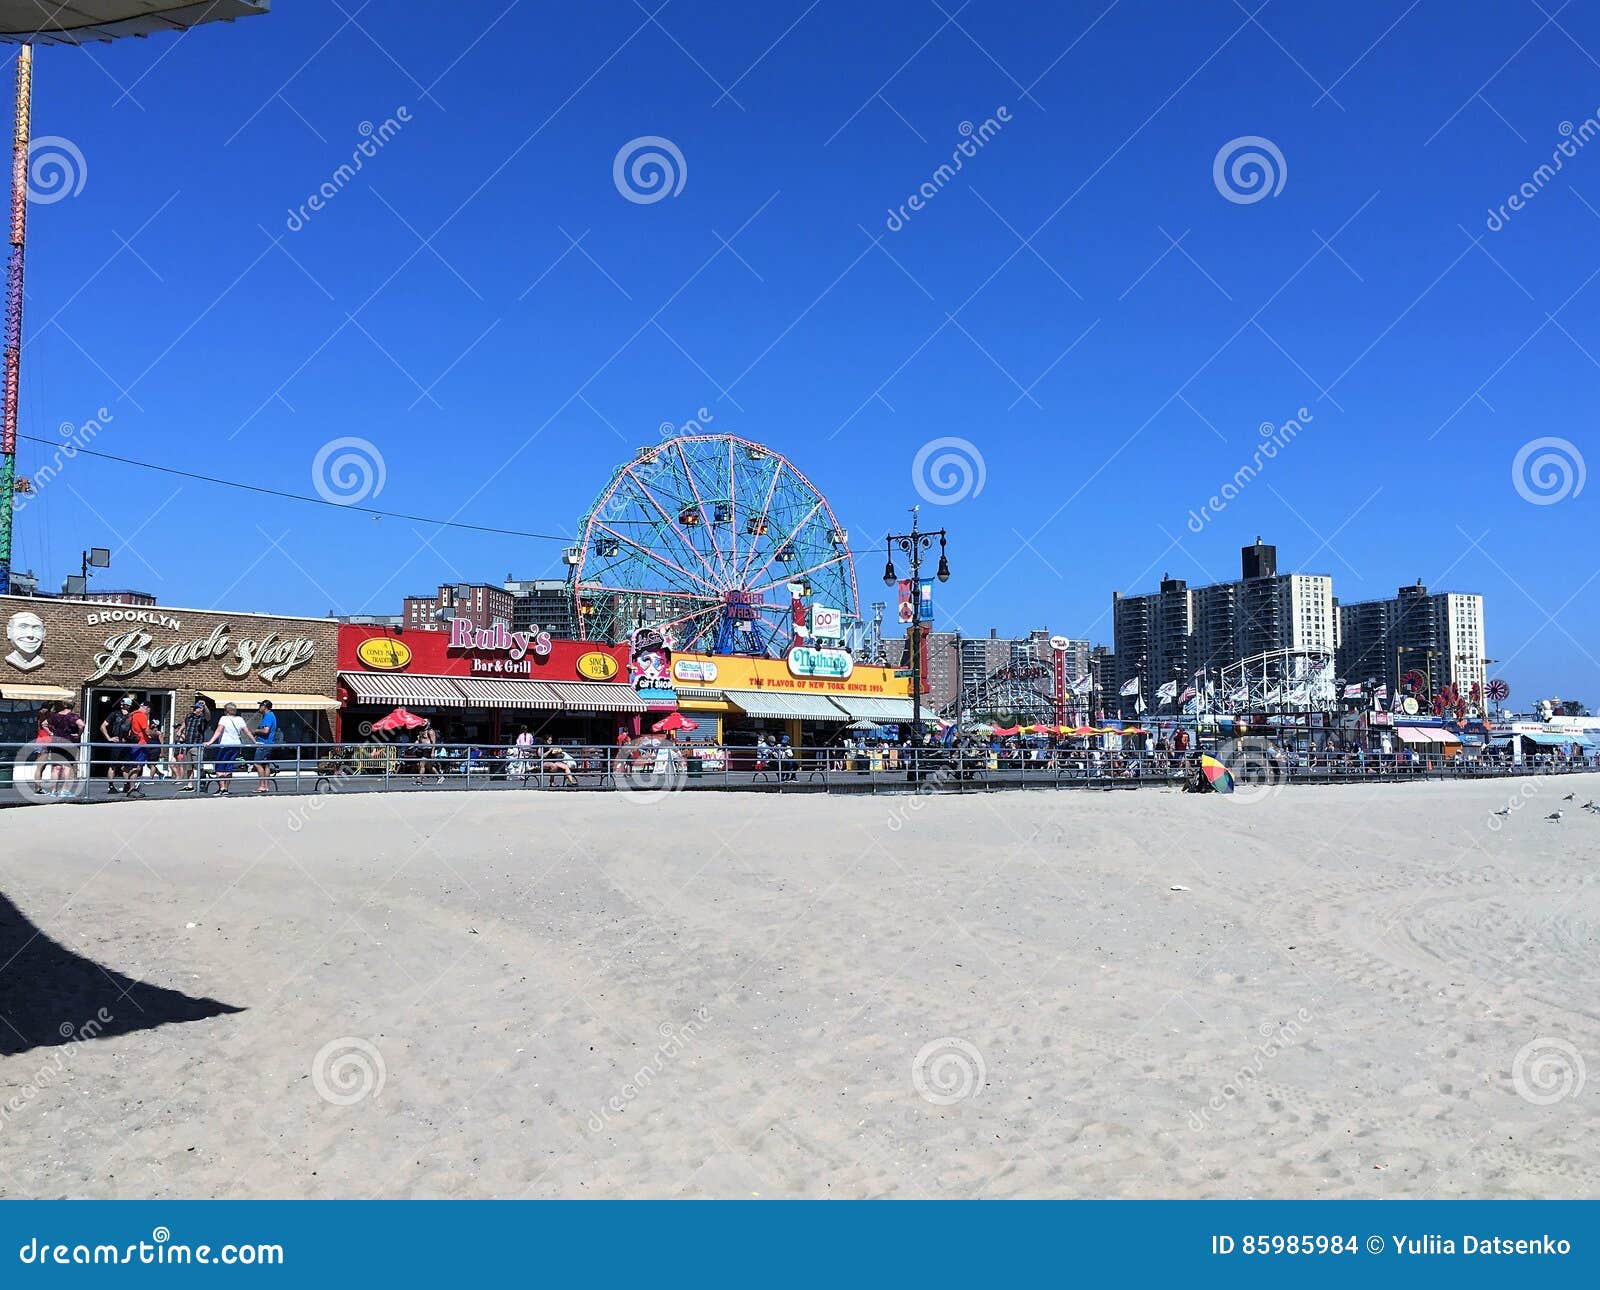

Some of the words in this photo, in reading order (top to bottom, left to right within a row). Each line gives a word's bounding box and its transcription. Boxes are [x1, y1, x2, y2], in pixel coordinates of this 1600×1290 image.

[87, 610, 181, 631] BROOKLYN
[447, 617, 552, 660] Ruby's
[84, 621, 231, 682] Beach
[473, 658, 493, 672] Bar
[494, 660, 503, 672] &
[504, 659, 532, 673] Grill
[640, 681, 654, 689] GIFT
[655, 680, 674, 690] SHOP
[749, 678, 762, 687] THE
[767, 679, 795, 688] FLAVOR
[797, 680, 807, 688] OF
[809, 681, 826, 690] NEW
[828, 682, 846, 691] YORK
[848, 683, 867, 692] SINCE
